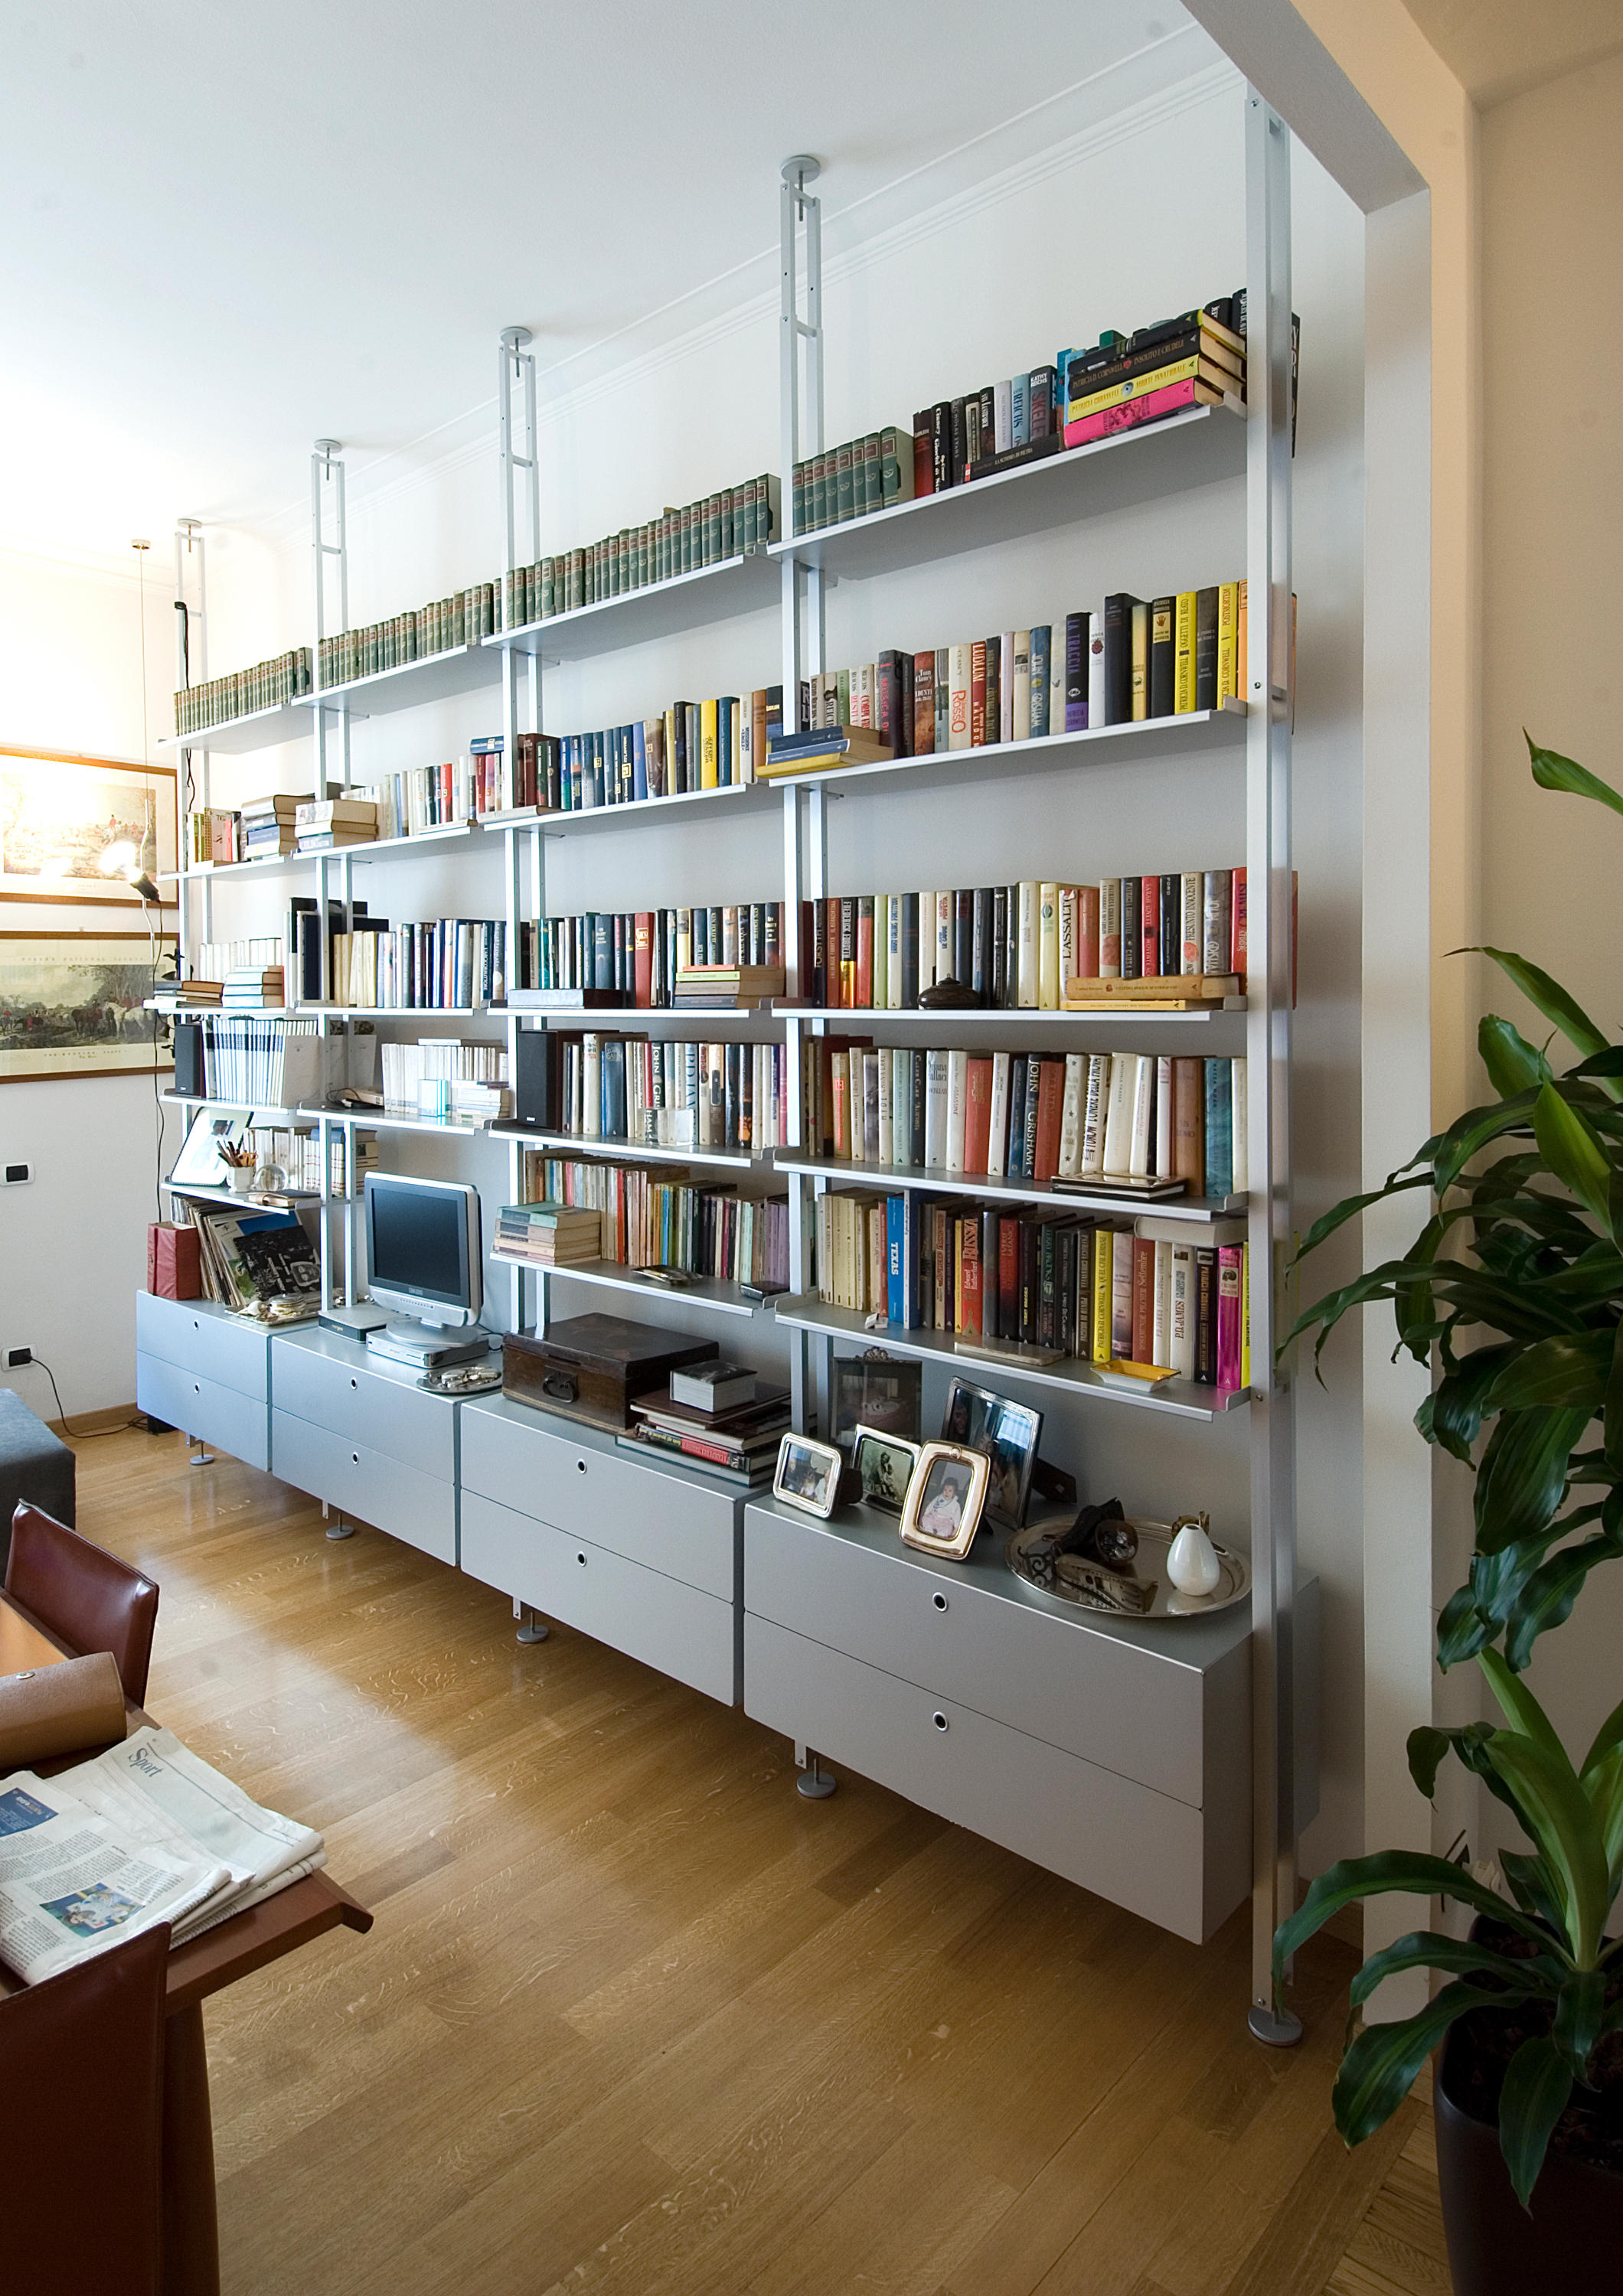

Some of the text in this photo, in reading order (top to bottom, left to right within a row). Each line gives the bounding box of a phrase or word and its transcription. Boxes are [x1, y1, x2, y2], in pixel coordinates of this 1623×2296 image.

[972, 644, 985, 682] LUDLUM
[1067, 618, 1080, 675] LA TRACCIA
[1031, 654, 1044, 728] JOHN GRISHAM
[843, 902, 851, 958] FREDERICK FORSYTH
[652, 1043, 661, 1074] JOHN
[1026, 1059, 1041, 1165] JOHN GRISHAM
[1137, 1251, 1148, 1287] Settembre
[1175, 1300, 1185, 1326] JAMES
[128, 1747, 164, 1778] Sport
